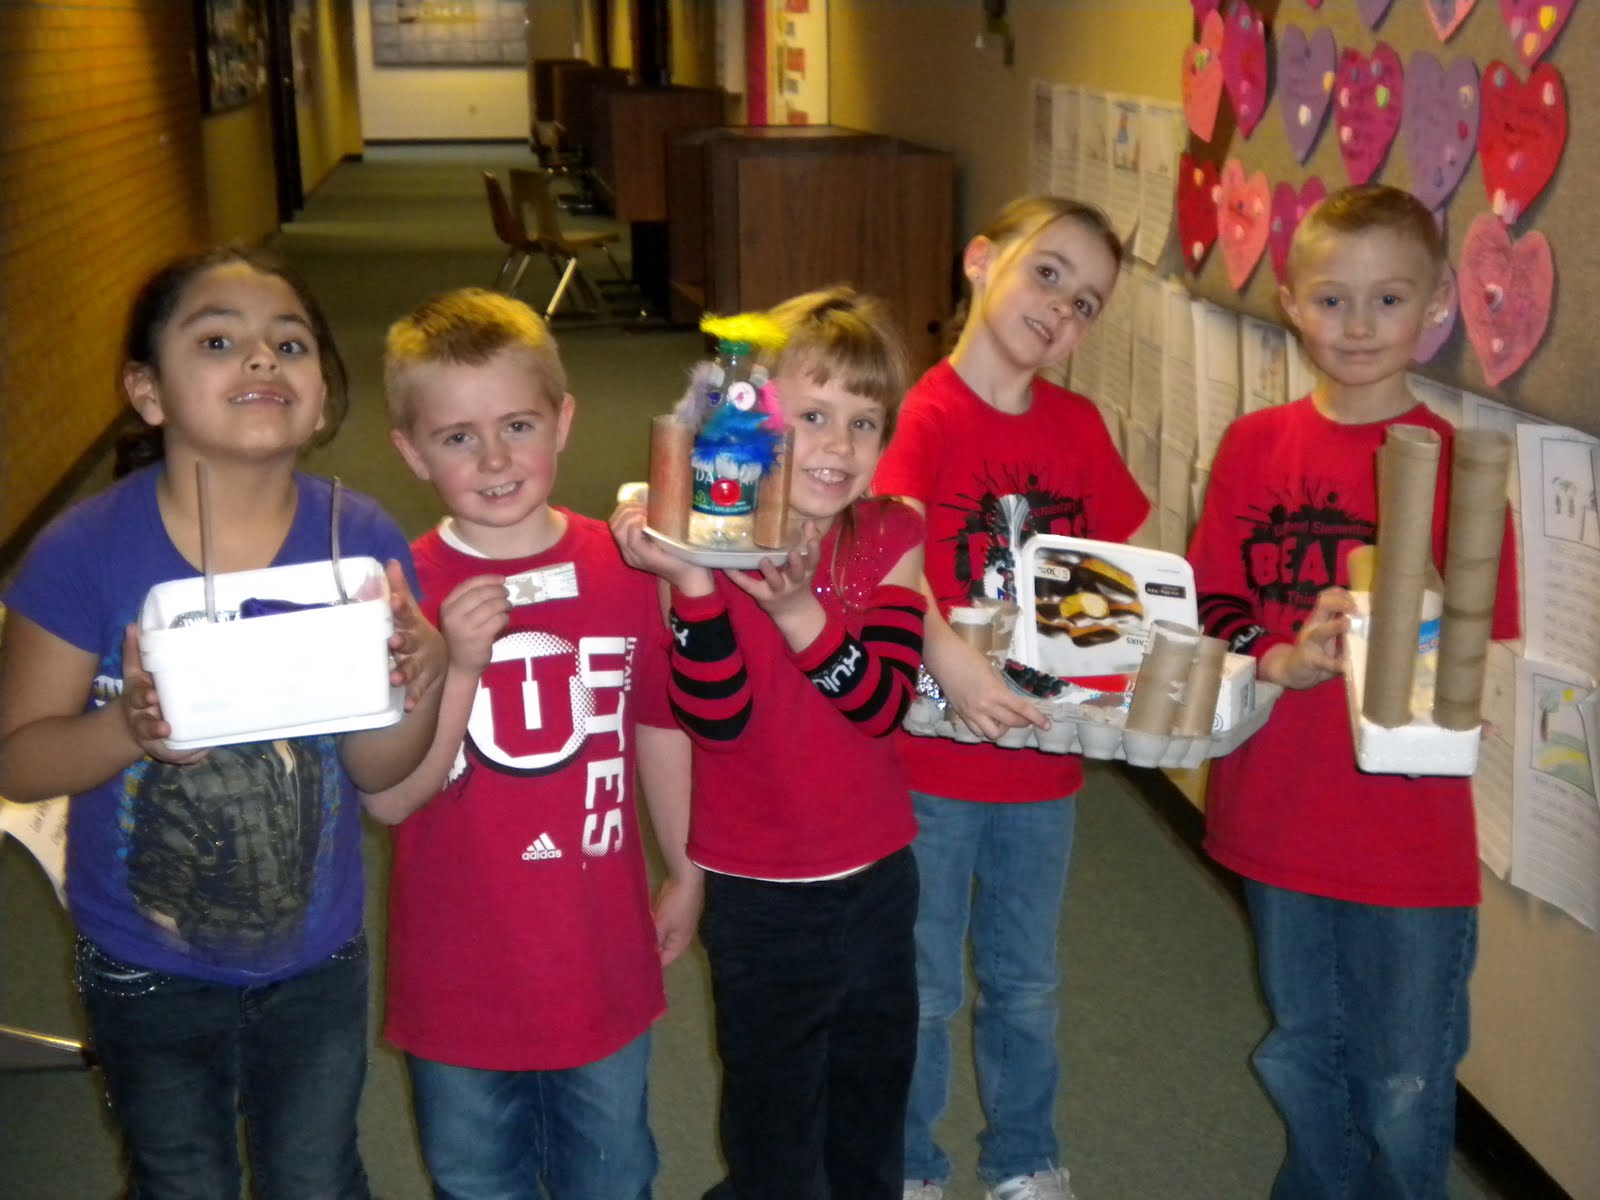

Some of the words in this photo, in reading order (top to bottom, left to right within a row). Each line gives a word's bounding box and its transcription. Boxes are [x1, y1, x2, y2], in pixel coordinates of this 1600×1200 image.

[625, 637, 637, 692] UTAH
[579, 637, 625, 857] UTES
[521, 849, 562, 861] adidas
